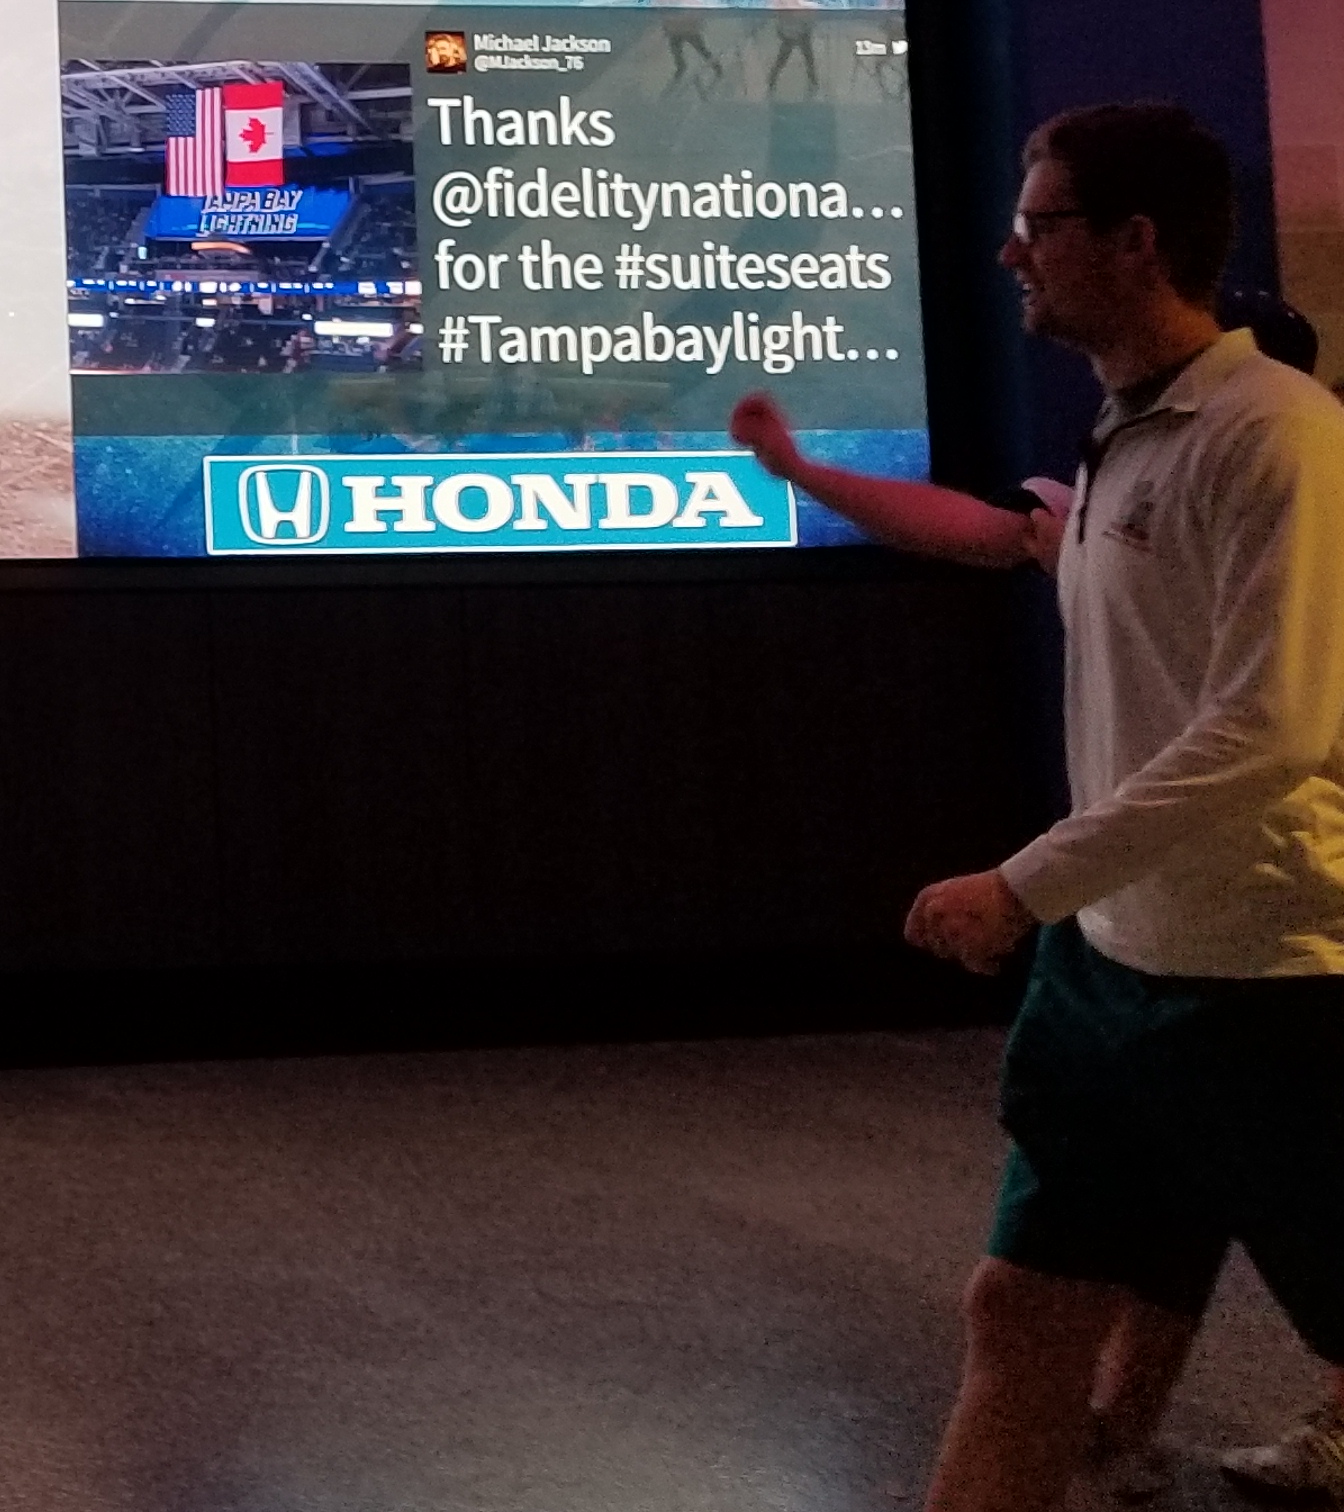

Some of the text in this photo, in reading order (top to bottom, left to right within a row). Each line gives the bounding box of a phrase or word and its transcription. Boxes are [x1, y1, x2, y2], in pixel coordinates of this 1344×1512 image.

[473, 33, 612, 53] Michael Jackson
[427, 95, 616, 147] Thanks
[432, 165, 904, 231] @fidelitynationa...
[434, 239, 893, 290] for the #suiteseats
[438, 310, 900, 375] #Tampabaylight...
[342, 471, 765, 533] HONDA
